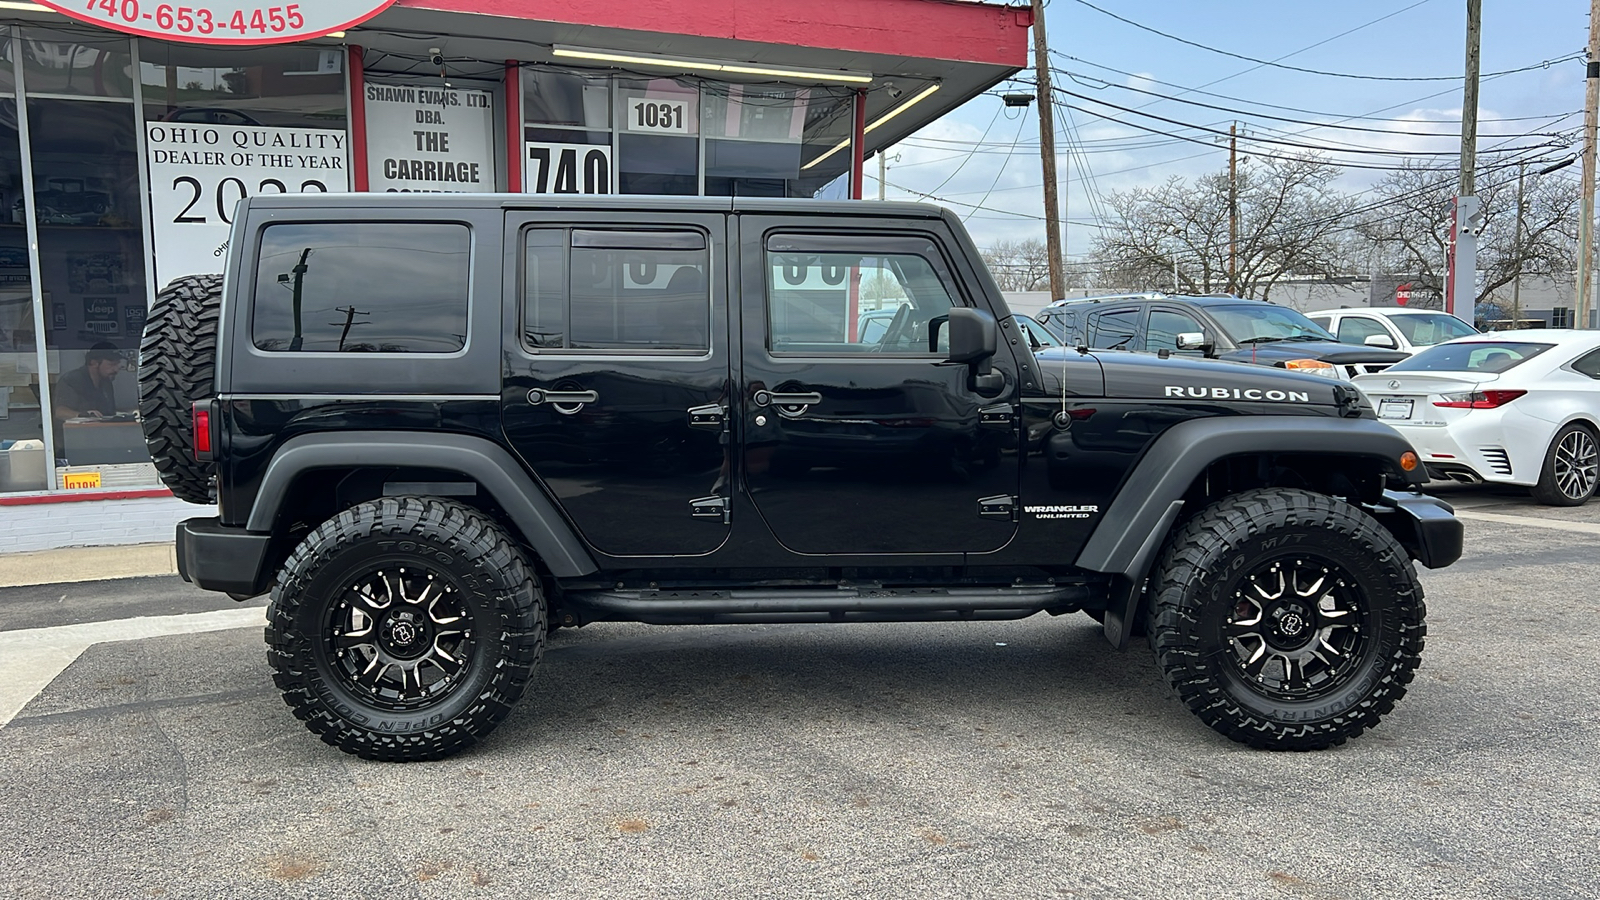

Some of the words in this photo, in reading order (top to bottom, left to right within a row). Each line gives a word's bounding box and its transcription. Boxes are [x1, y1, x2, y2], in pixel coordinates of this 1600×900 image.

[367, 86, 415, 103] SHAWN
[418, 90, 461, 106] EVANS.
[466, 93, 491, 108] LTD.
[415, 109, 446, 125] DBA.
[634, 102, 684, 129] 1031
[149, 127, 219, 145] OHIO
[232, 130, 344, 149] QUALITY
[413, 130, 449, 152] THE
[154, 149, 226, 166] DEALER
[230, 152, 254, 167] OF
[257, 153, 294, 168] THE
[297, 155, 343, 170] YEAR
[383, 158, 480, 183] CARRIAGE
[529, 147, 609, 195] 740
[172, 176, 328, 224] 20
[86, 300, 115, 316] Jeep
[1164, 385, 1310, 402] RUBICON
[1024, 505, 1099, 513] WRANGLER
[377, 541, 454, 565] TOYO
[1267, 676, 1373, 720] COUNTRY
[377, 712, 444, 733] OPEN
